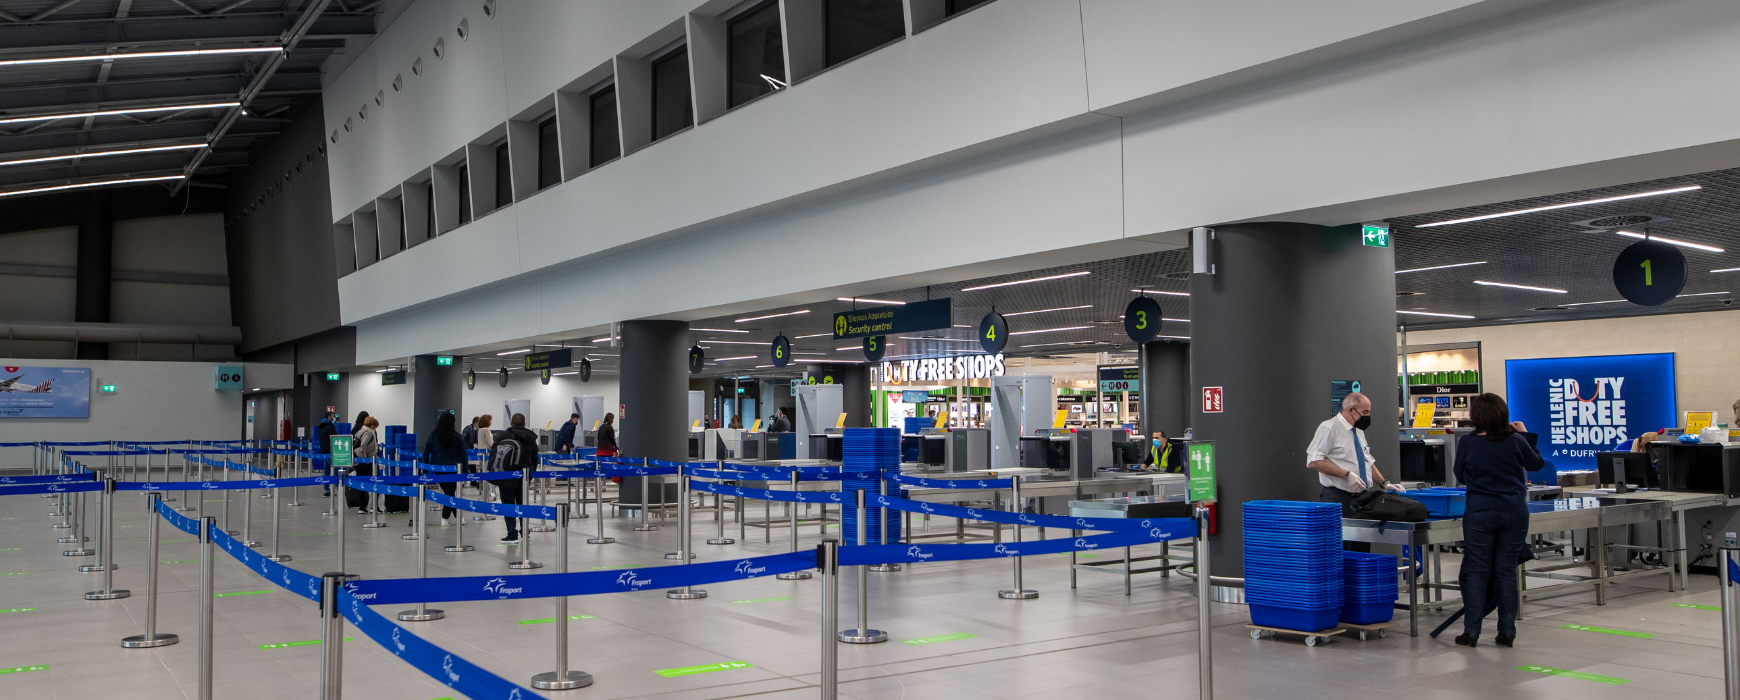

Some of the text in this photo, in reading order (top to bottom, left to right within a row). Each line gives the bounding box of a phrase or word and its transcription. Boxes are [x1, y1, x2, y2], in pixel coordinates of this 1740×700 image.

[1640, 259, 1652, 286] 1
[848, 321, 893, 335] Security control
[1136, 310, 1147, 330] 3
[986, 325, 996, 342] 4
[776, 345, 783, 359] 6
[869, 336, 877, 352] 5
[692, 354, 698, 366] 7
[919, 357, 955, 381] FREE
[955, 353, 1005, 379] SHOPS
[1549, 378, 1566, 445] HELLENIC
[1564, 400, 1627, 426] FREE
[1565, 426, 1628, 445] SHOPS
[747, 565, 766, 574] Fraport
[499, 586, 523, 595] Fraport
[631, 578, 652, 587] Fraport
